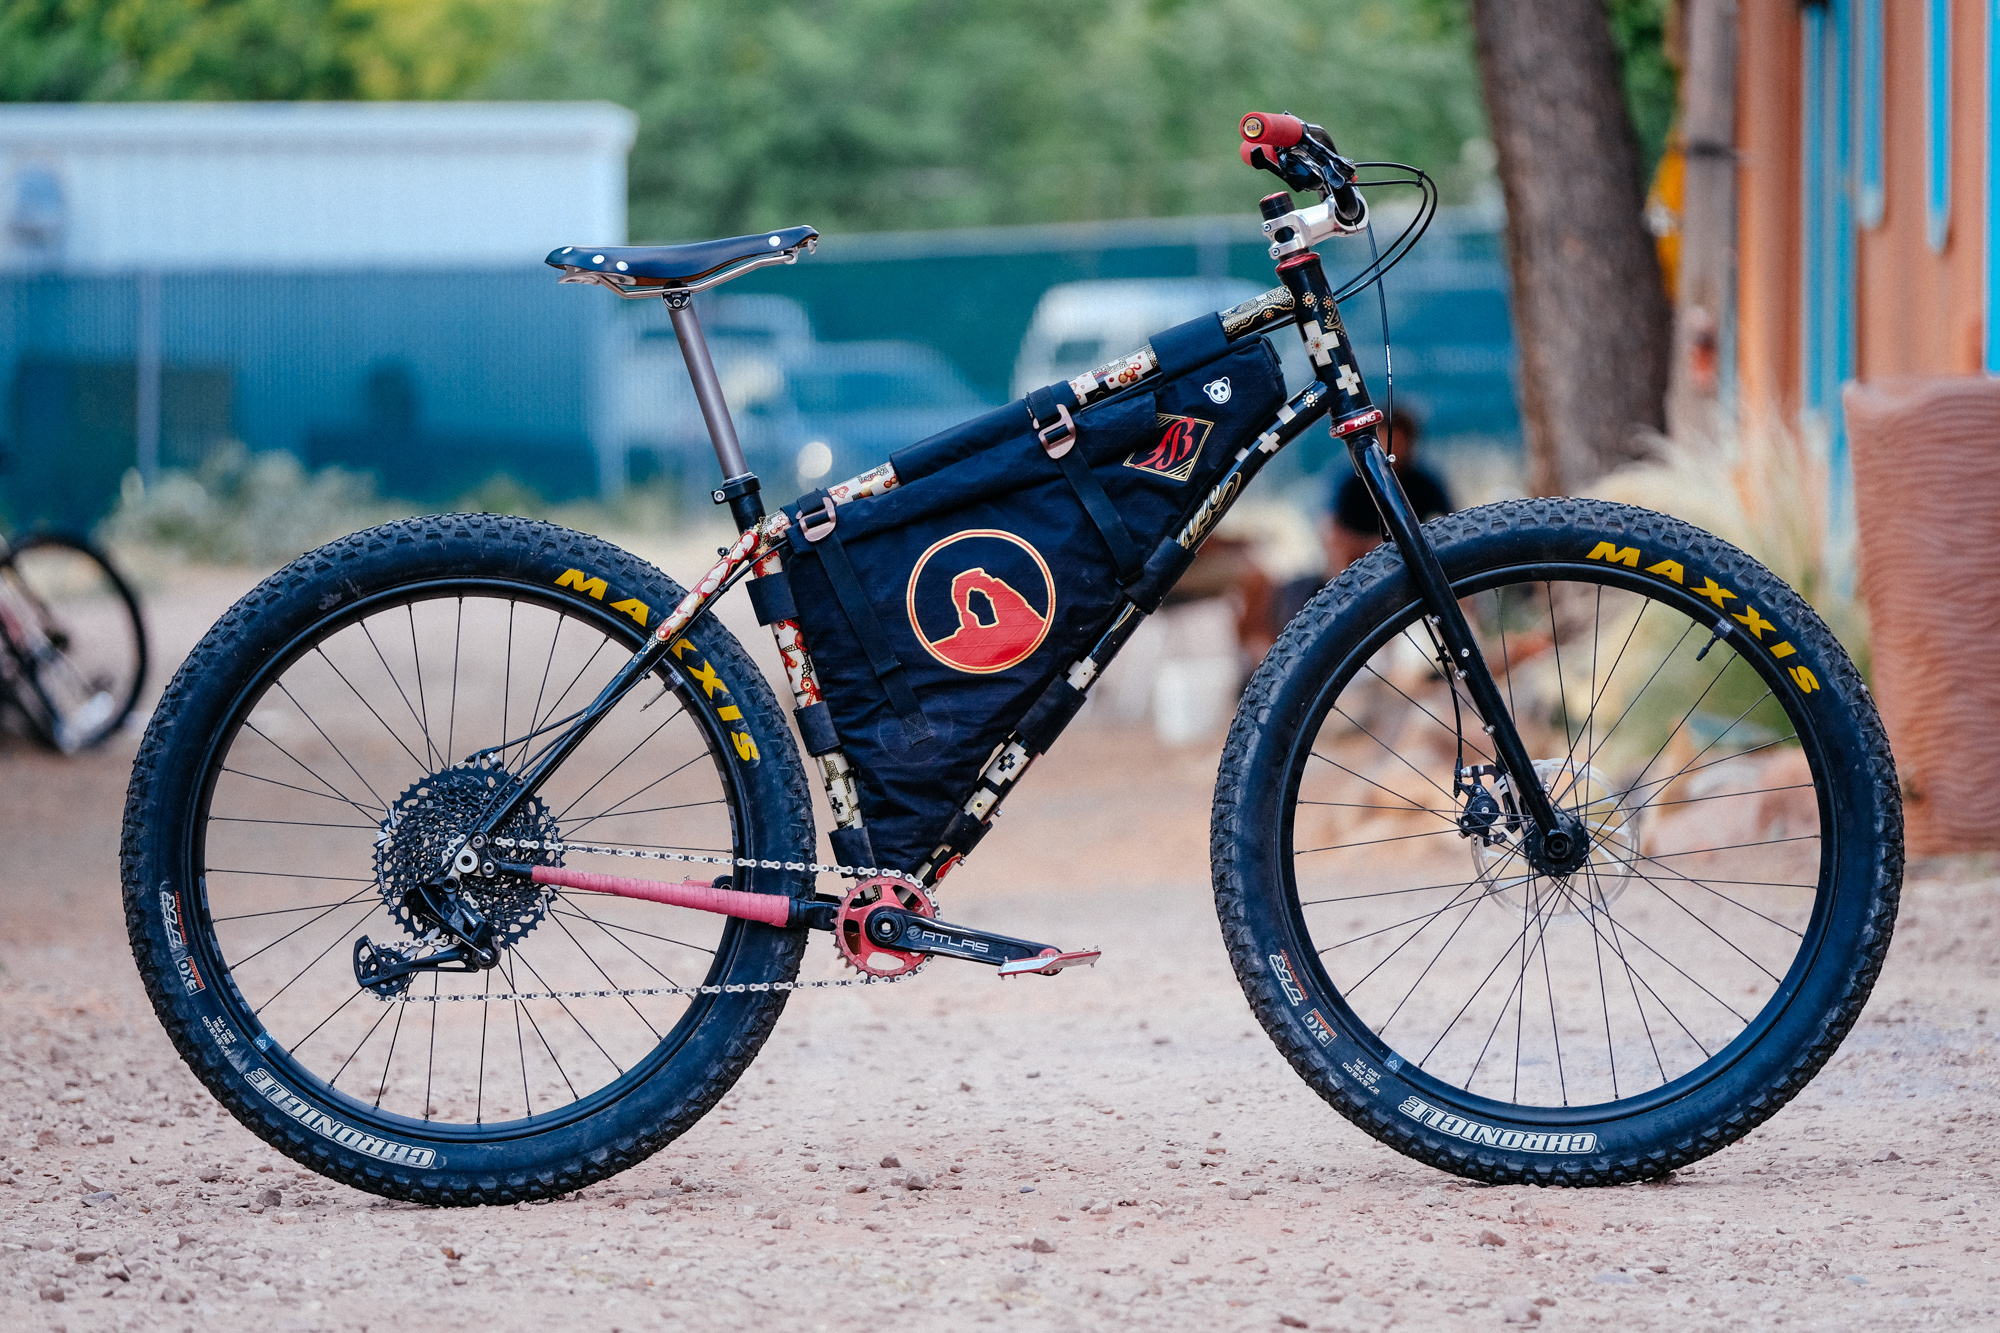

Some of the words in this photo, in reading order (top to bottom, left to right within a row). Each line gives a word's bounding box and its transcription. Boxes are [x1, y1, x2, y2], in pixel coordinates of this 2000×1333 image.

[1354, 413, 1376, 427] KING
[1585, 541, 1821, 694] MAXXIS
[550, 826, 560, 857] TECHNGY
[377, 863, 388, 895] TECHNOLOGY
[385, 895, 396, 910] EAGLE
[162, 891, 183, 949] TR
[177, 914, 188, 946] TUBELESS
[921, 930, 990, 953] ATLAS
[1280, 948, 1292, 970] READY
[178, 960, 200, 996] EXO
[1269, 954, 1304, 1006] TR
[1290, 970, 1309, 1000] TUBELESS
[212, 1020, 223, 1034] PSI
[216, 1015, 226, 1029] TPI
[225, 1028, 238, 1043] 120
[1304, 1013, 1332, 1045] EXO
[1342, 1061, 1380, 1095] 27.5X3.00
[1352, 1063, 1366, 1076] PSI
[1355, 1057, 1367, 1070] TPI
[1367, 1067, 1381, 1080] 120
[244, 1067, 437, 1169] CHRONICLE
[1398, 1095, 1598, 1154] CHRONICLE
